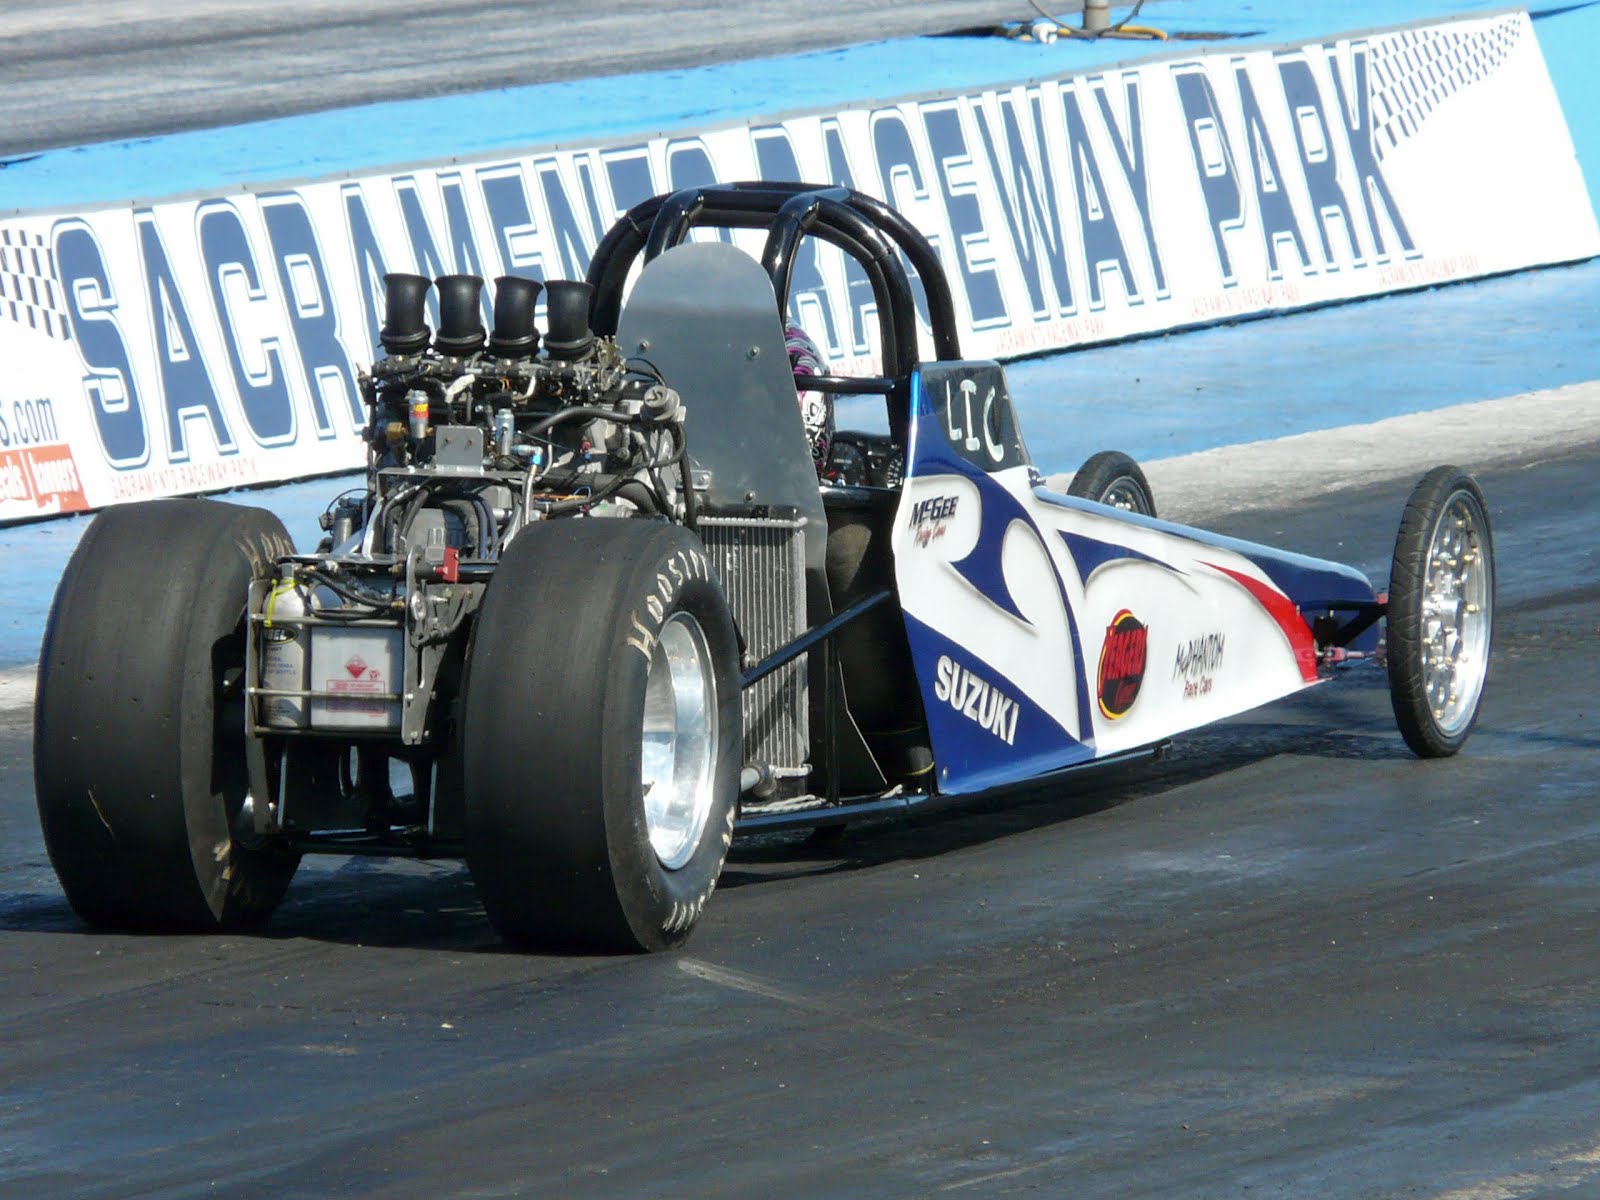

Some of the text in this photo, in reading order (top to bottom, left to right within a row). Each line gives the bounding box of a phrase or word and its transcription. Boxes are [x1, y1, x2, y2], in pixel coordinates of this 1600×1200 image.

[50, 137, 721, 470] SACRAMEN
[1169, 40, 1423, 287] PARK
[935, 655, 1019, 746] SUZUKI
